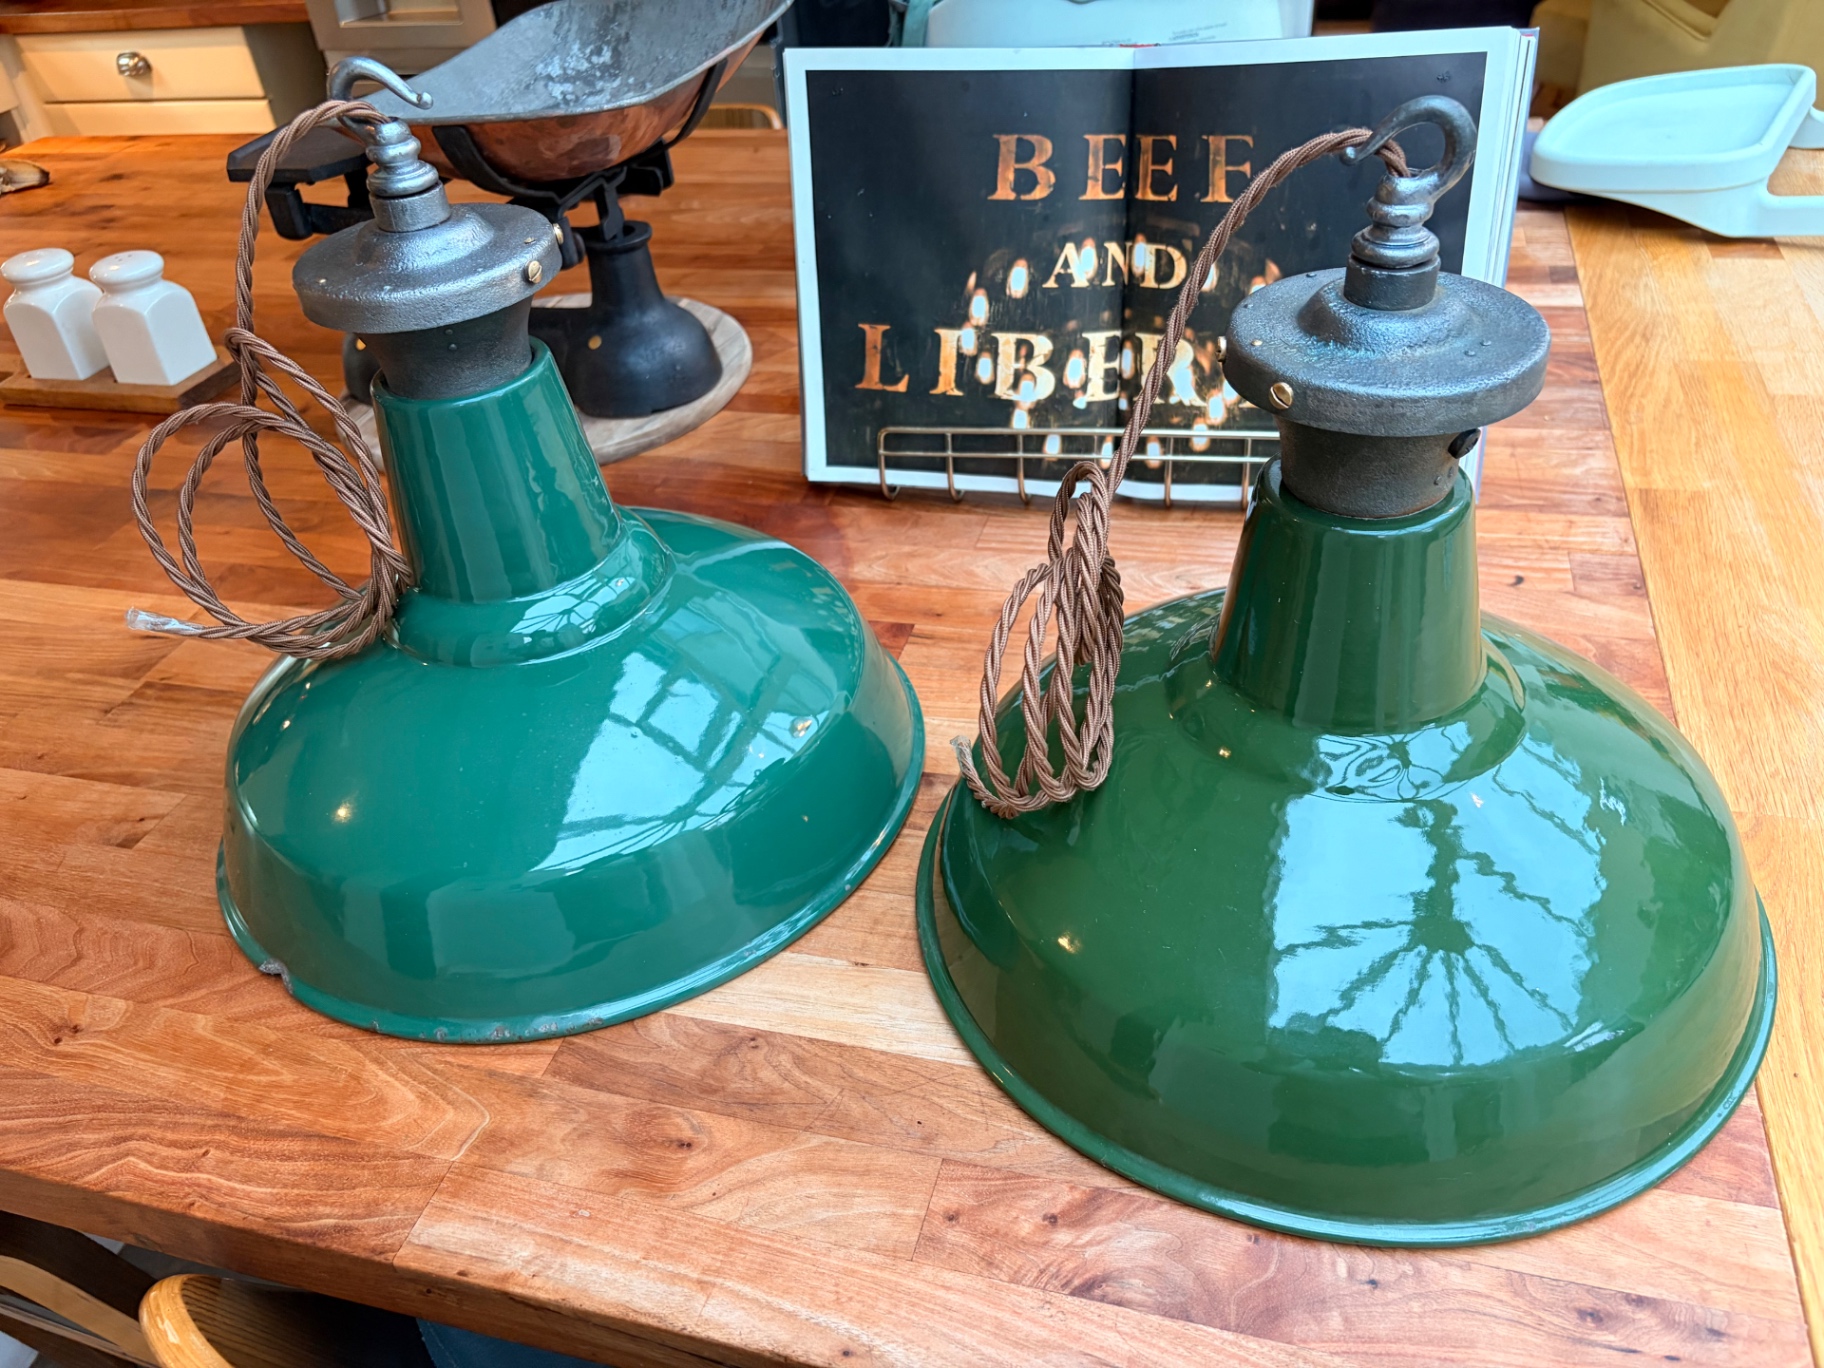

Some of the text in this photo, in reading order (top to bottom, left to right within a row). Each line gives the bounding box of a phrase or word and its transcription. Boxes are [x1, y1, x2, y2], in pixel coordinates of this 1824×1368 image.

[987, 133, 1255, 203] BEEF
[1042, 241, 1188, 289] AND
[855, 323, 1257, 408] LIBER
